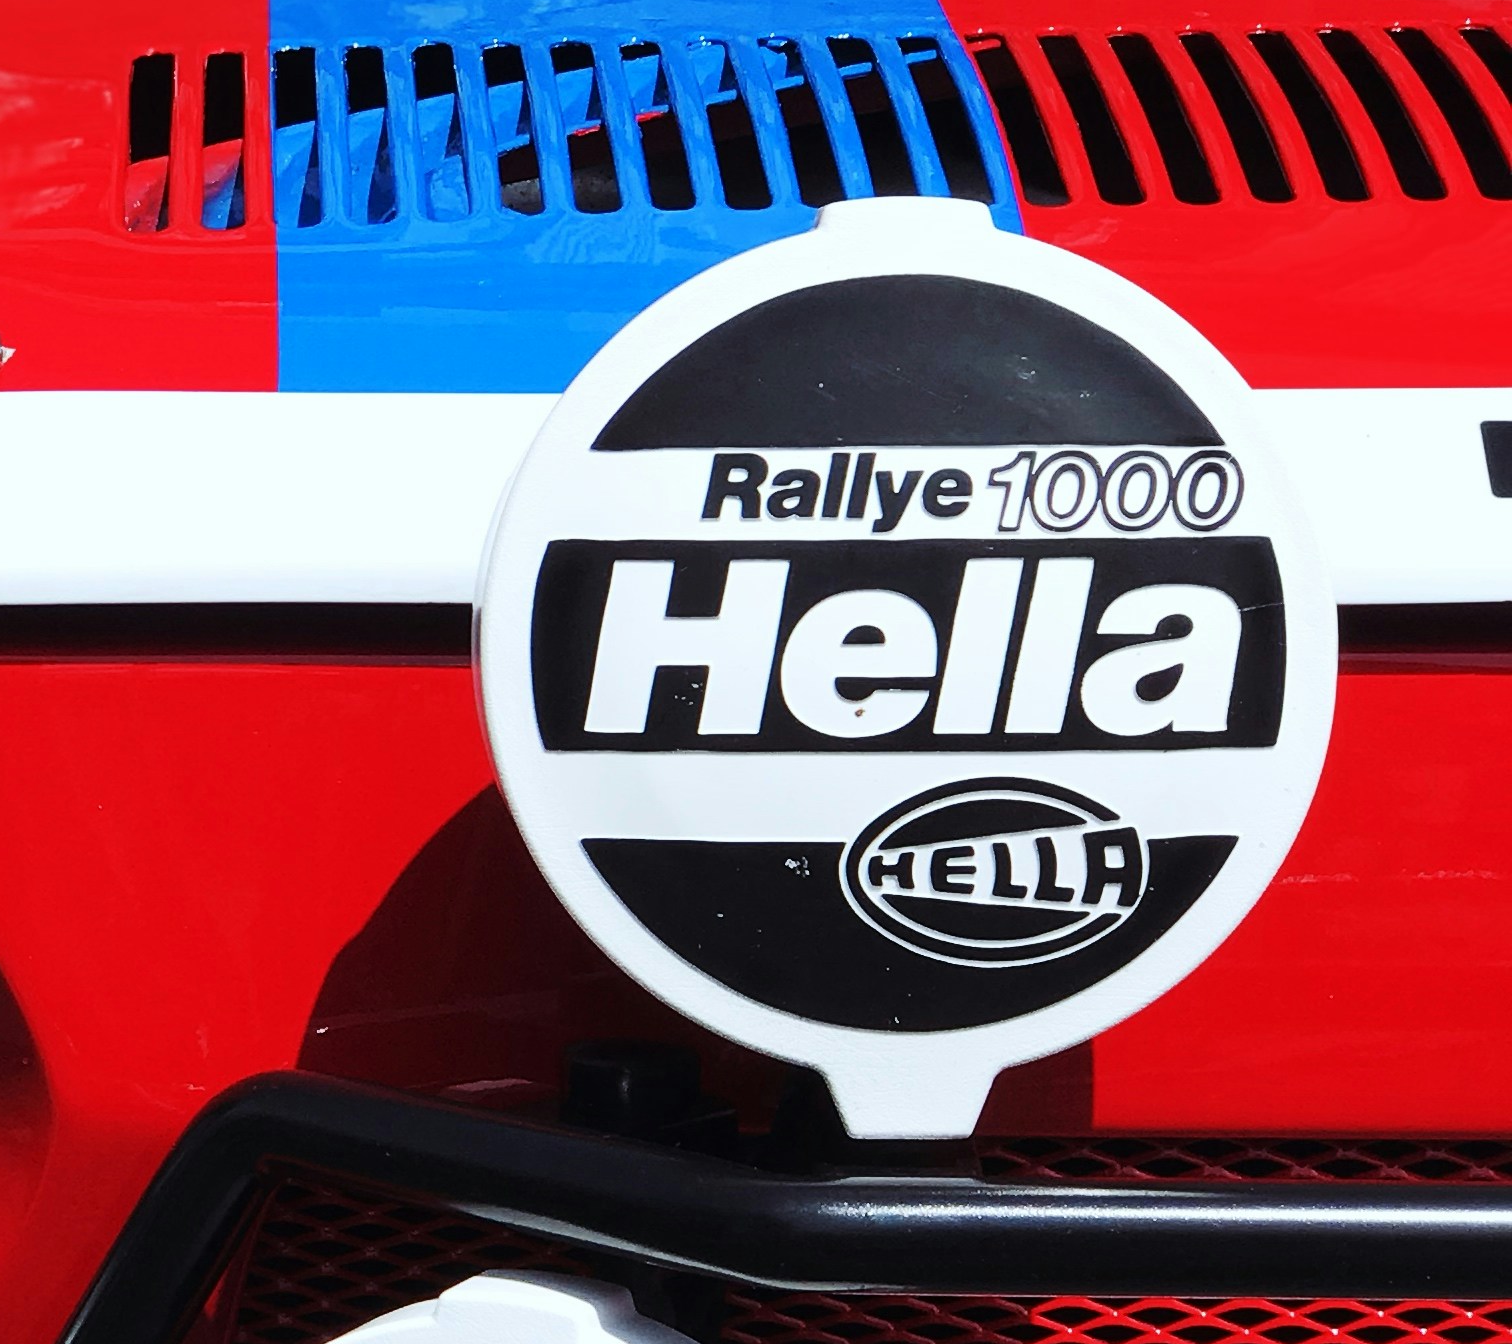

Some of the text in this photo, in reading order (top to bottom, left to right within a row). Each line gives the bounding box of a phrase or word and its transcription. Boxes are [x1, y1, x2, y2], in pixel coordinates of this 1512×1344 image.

[702, 451, 1245, 533] Rallye 1000
[584, 558, 1242, 737] Hella
[868, 826, 1144, 907] HELLA
